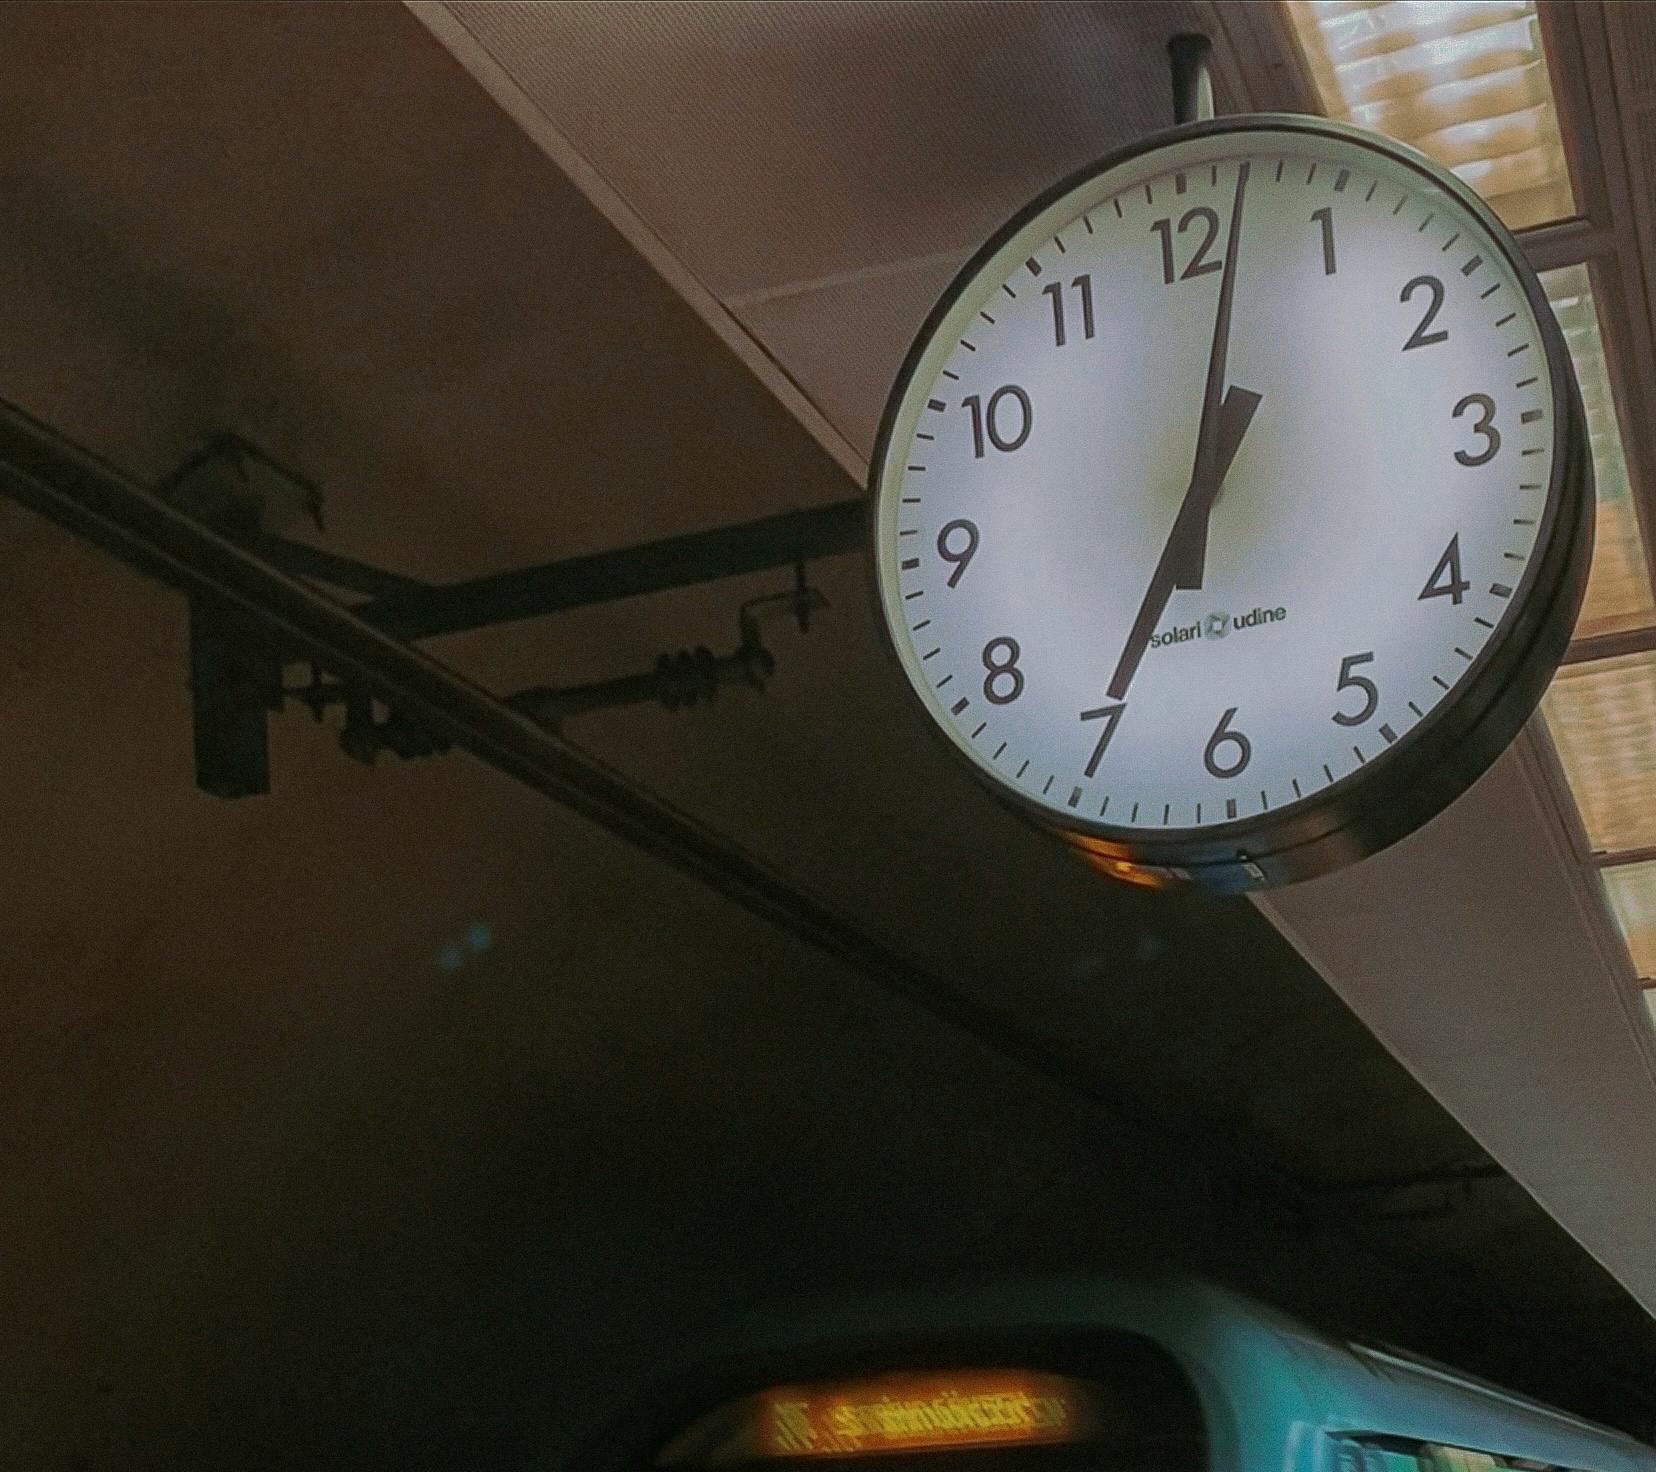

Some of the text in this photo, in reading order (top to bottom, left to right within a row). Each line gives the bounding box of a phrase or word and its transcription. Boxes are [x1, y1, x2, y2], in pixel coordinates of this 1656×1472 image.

[1150, 207, 1222, 284] 12
[1309, 207, 1336, 275] 1
[1042, 274, 1094, 346] 11
[1400, 275, 1448, 351] 2
[961, 385, 1032, 458] 10
[1452, 393, 1501, 467] 3
[937, 519, 979, 589] 9
[1418, 532, 1470, 605] 4
[1149, 606, 1287, 648] solari udine
[983, 637, 1024, 705] 8
[1332, 652, 1378, 726] 5
[1081, 703, 1127, 778] 7
[1204, 708, 1251, 779] 6
